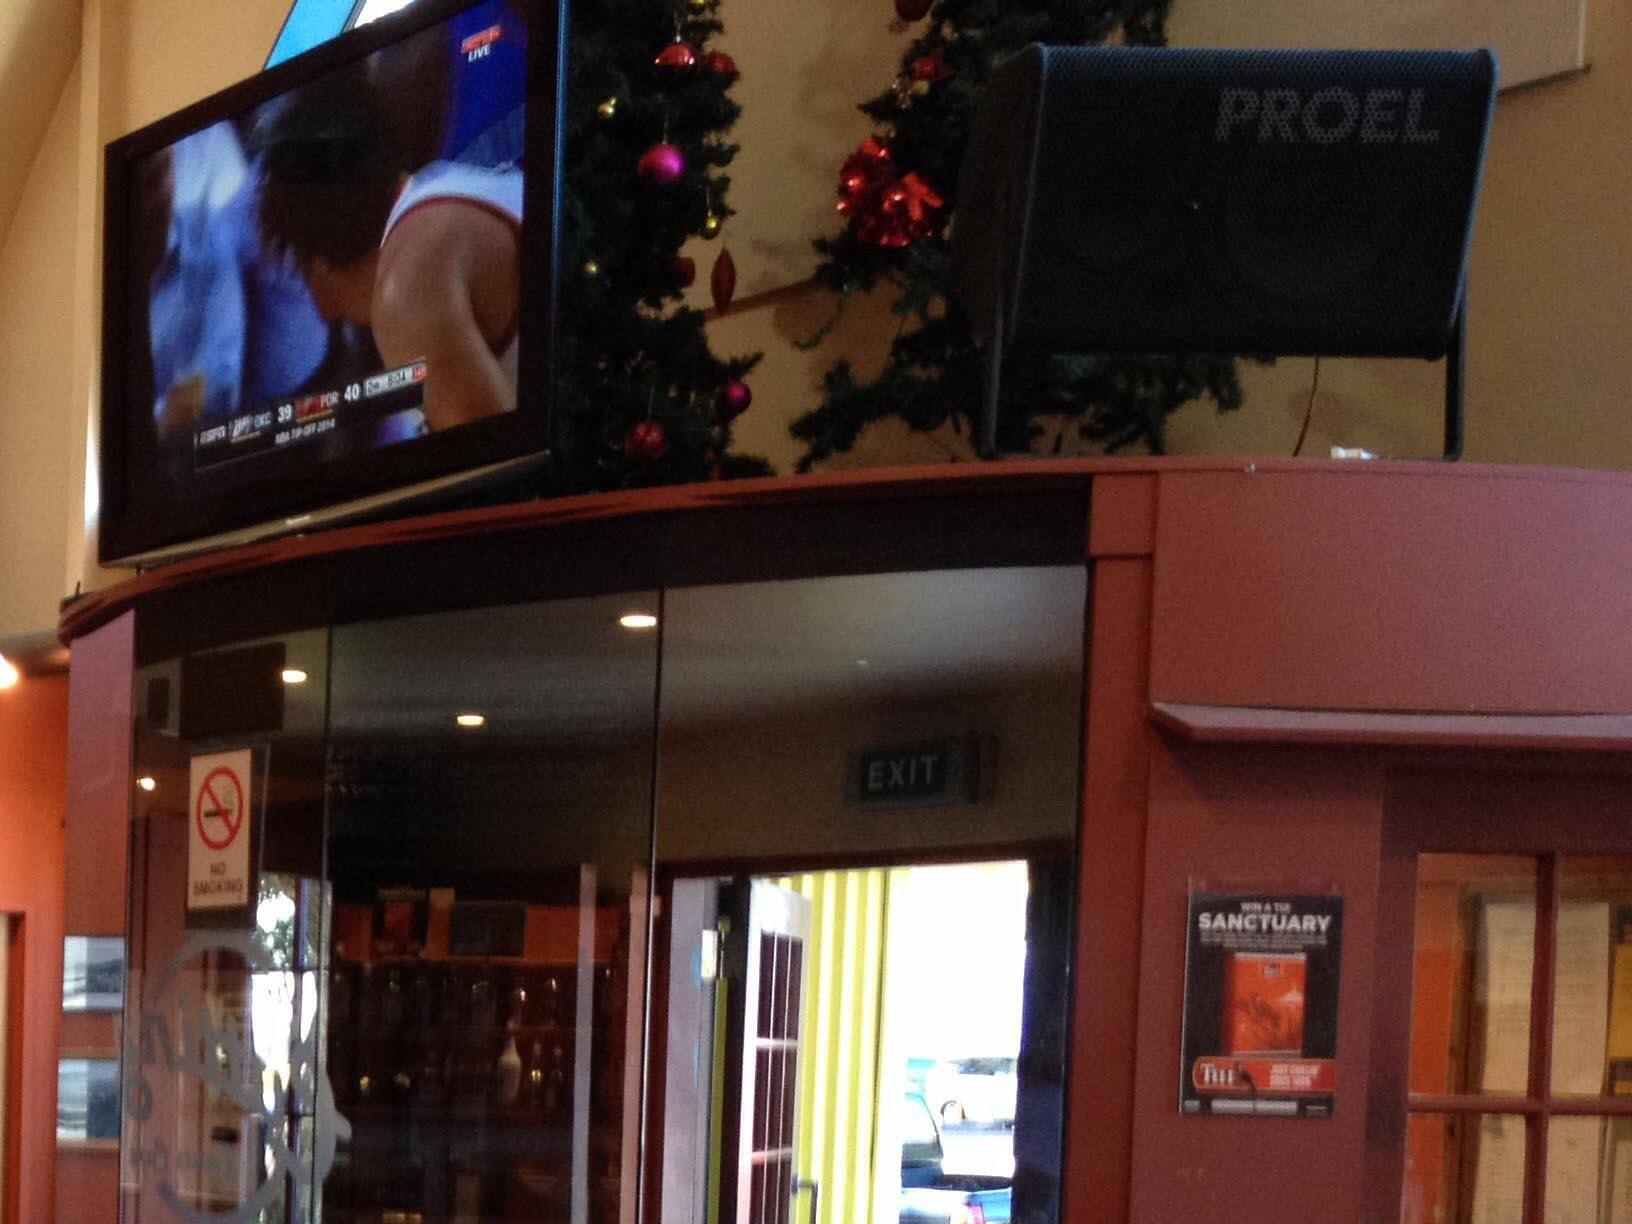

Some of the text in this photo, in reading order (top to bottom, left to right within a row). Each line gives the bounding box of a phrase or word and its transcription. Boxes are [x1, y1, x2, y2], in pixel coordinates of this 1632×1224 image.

[468, 43, 490, 62] LIVE
[1216, 87, 1441, 143] PROEL
[277, 404, 292, 423] 39
[320, 392, 338, 409] POR
[344, 383, 360, 402] 40
[867, 754, 939, 791] EXIT
[210, 862, 226, 876] NO
[193, 877, 243, 896] SMOKING
[1198, 912, 1331, 931] SANCTUARY
